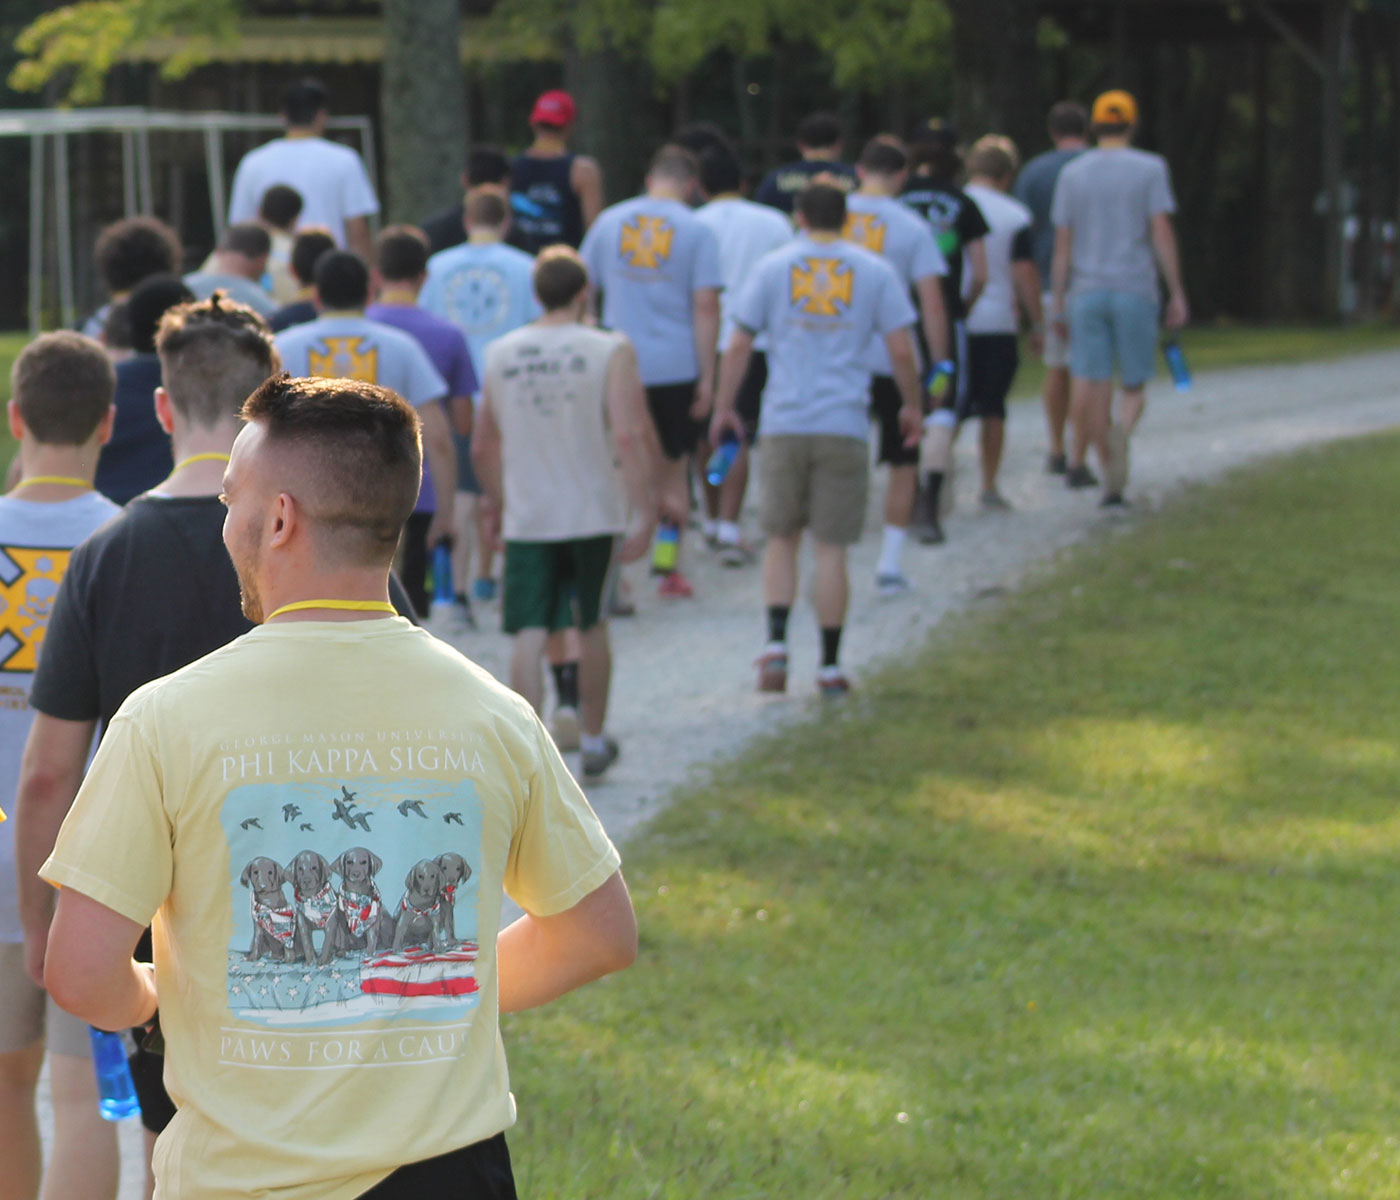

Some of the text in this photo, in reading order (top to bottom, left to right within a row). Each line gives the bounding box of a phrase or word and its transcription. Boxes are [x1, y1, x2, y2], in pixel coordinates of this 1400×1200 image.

[221, 745, 487, 781] PHI KAPPA SIGMA
[220, 1031, 468, 1062] PAWS FOR A CAU
